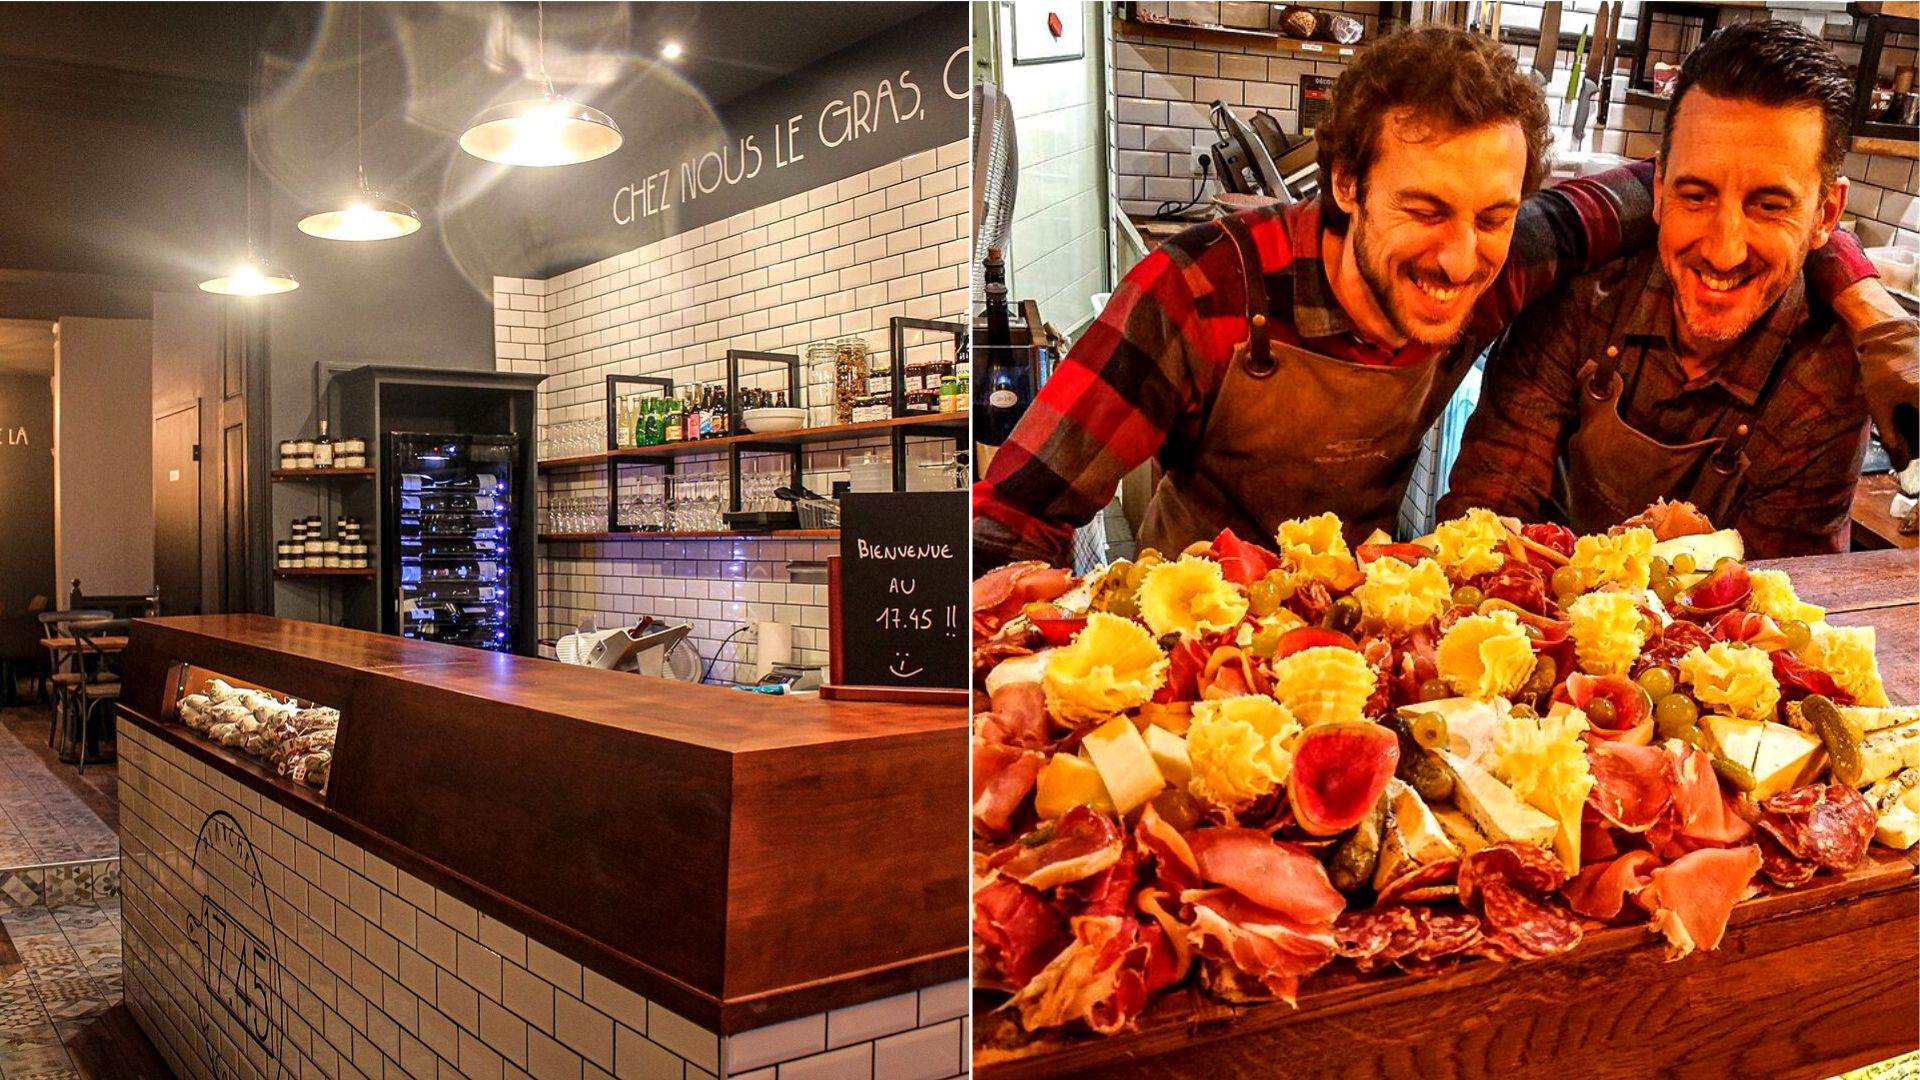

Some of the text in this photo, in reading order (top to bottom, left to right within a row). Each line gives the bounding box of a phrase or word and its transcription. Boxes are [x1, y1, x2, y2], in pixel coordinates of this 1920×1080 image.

[612, 169, 670, 226] CHEZ
[681, 134, 762, 203] NOUS
[775, 114, 805, 169] LE
[818, 70, 925, 148] GRAS,
[8, 426, 29, 446] LA
[857, 538, 953, 560] BIENVENUE
[889, 577, 915, 595] AU
[876, 607, 932, 630] 17.45
[204, 907, 269, 1042] 17.45
